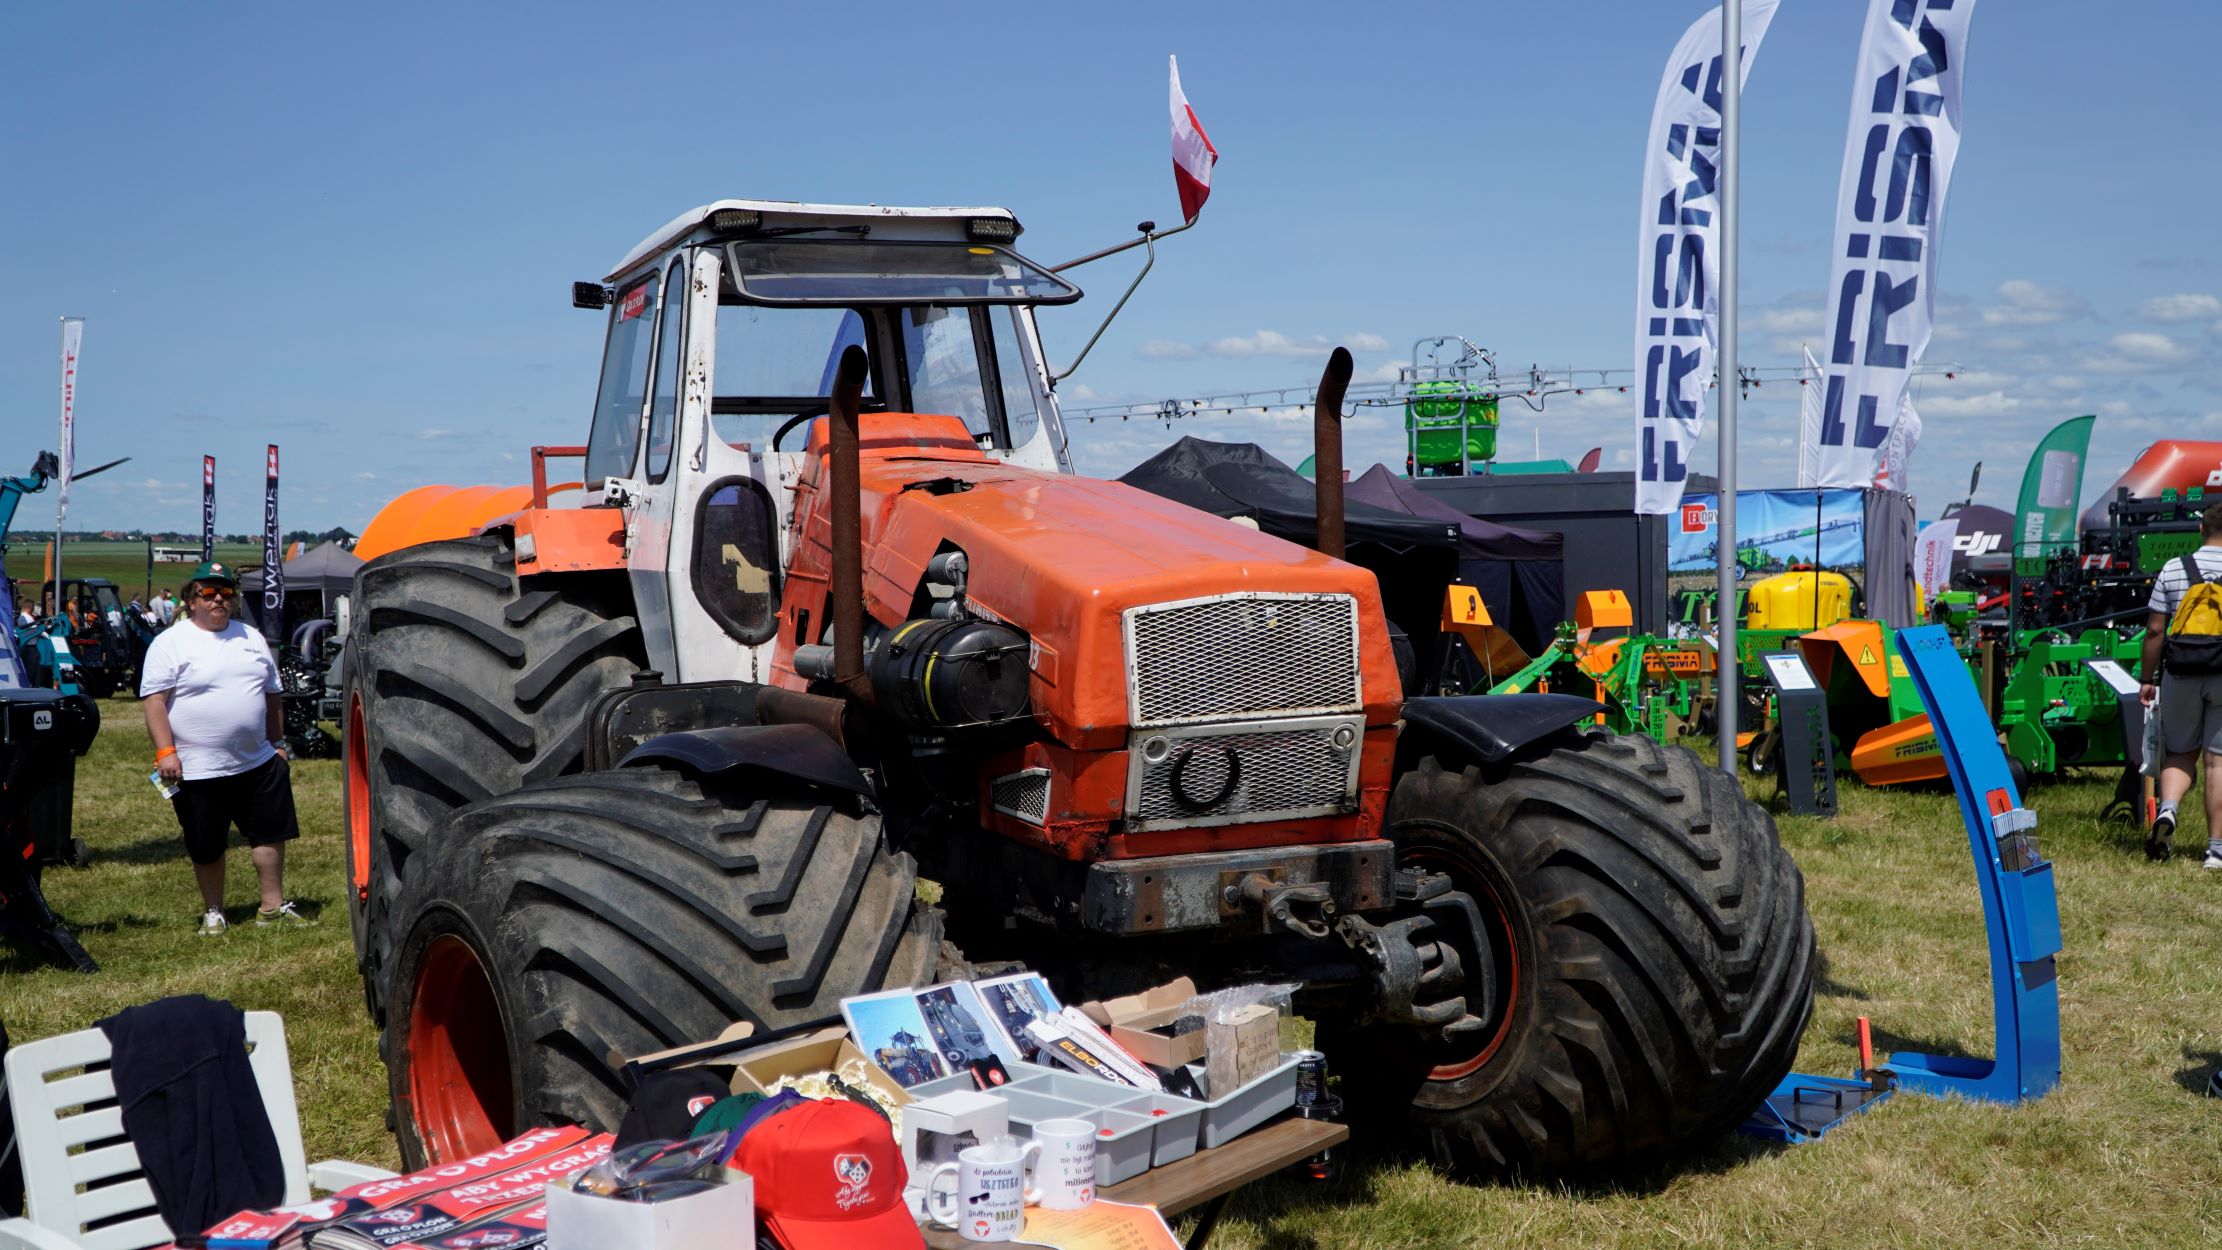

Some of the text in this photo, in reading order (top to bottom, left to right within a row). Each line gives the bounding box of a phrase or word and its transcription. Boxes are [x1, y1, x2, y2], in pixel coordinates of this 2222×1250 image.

[1821, 0, 1954, 449] FRISM
[1641, 45, 1746, 482] FRISMA
[1953, 531, 2001, 556] dji
[1644, 655, 1698, 668] FRISMA
[1895, 738, 1940, 758] FRISM
[357, 1129, 561, 1198] GRA O PLON
[450, 1180, 502, 1200] ABY
[373, 1226, 400, 1236] GRA
[412, 1217, 447, 1229] PLON
